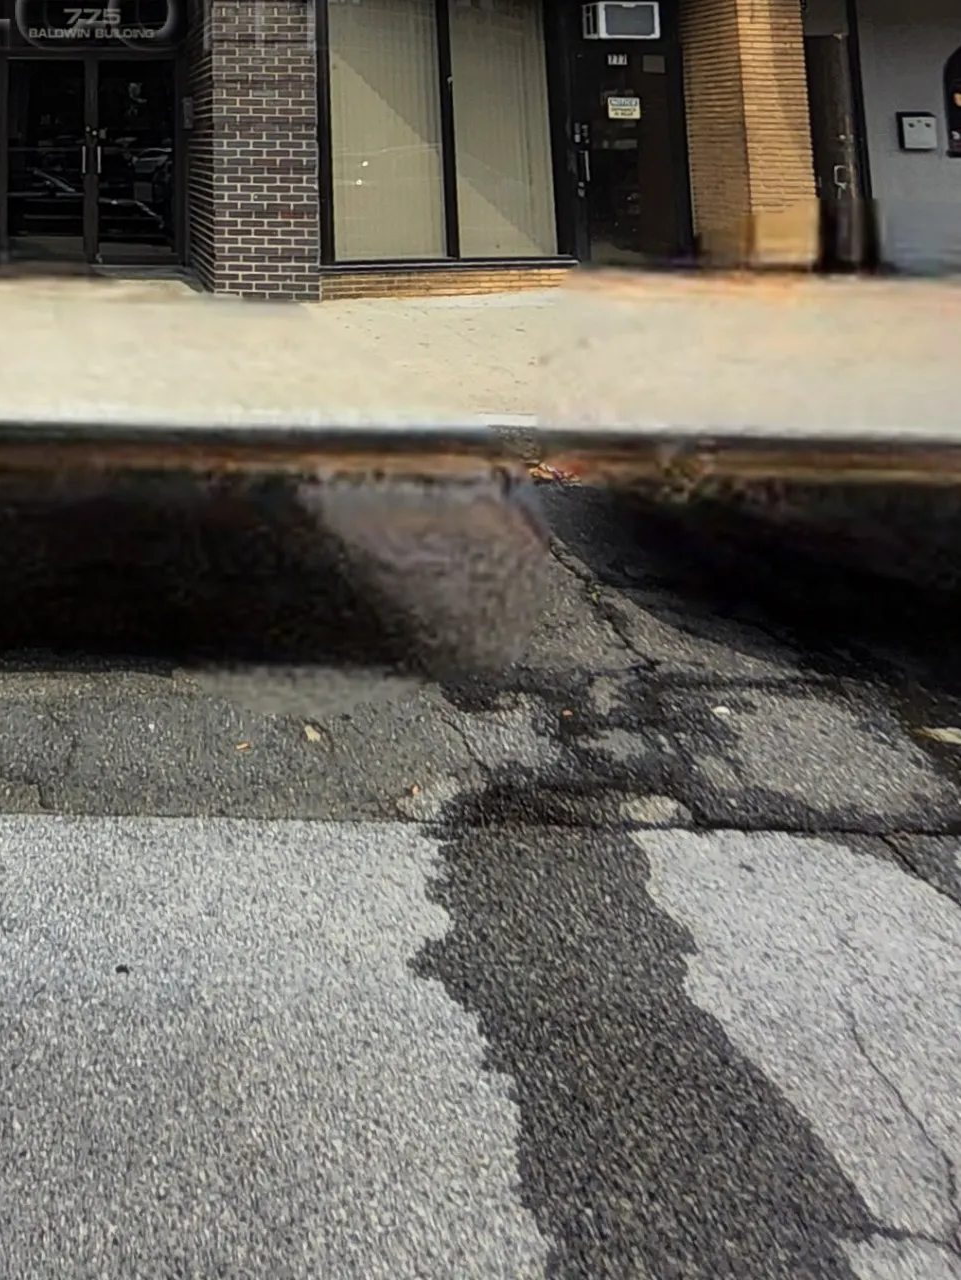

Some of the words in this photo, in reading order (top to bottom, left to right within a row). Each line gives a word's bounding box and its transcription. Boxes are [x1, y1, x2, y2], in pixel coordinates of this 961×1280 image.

[63, 8, 121, 25] 775
[28, 28, 90, 38] BALDWIN
[95, 28, 155, 38] BUILDING
